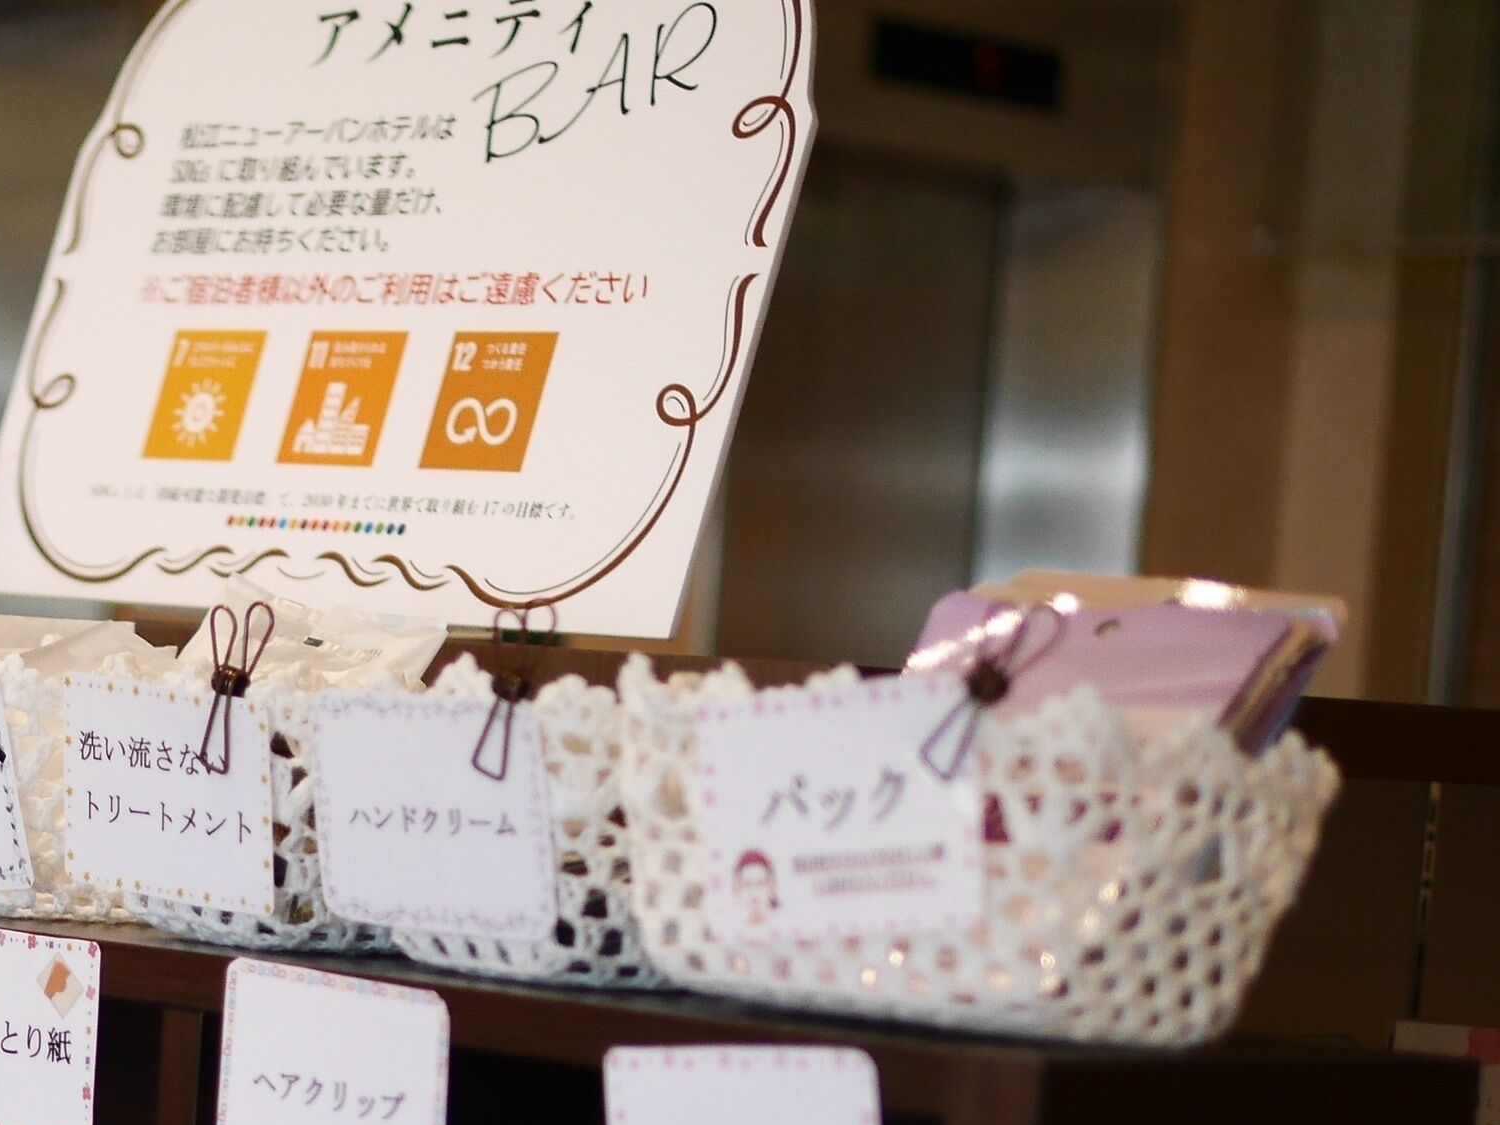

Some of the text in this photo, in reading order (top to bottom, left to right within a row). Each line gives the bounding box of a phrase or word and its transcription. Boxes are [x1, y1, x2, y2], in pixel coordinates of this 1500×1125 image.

[310, 0, 593, 65] アメニティ
[472, 2, 717, 162] BAR
[453, 341, 478, 371] 12
[86, 790, 252, 844] トリートメント
[349, 805, 518, 837] ハンドクリーム
[252, 1072, 406, 1121] ヘアクリップ
